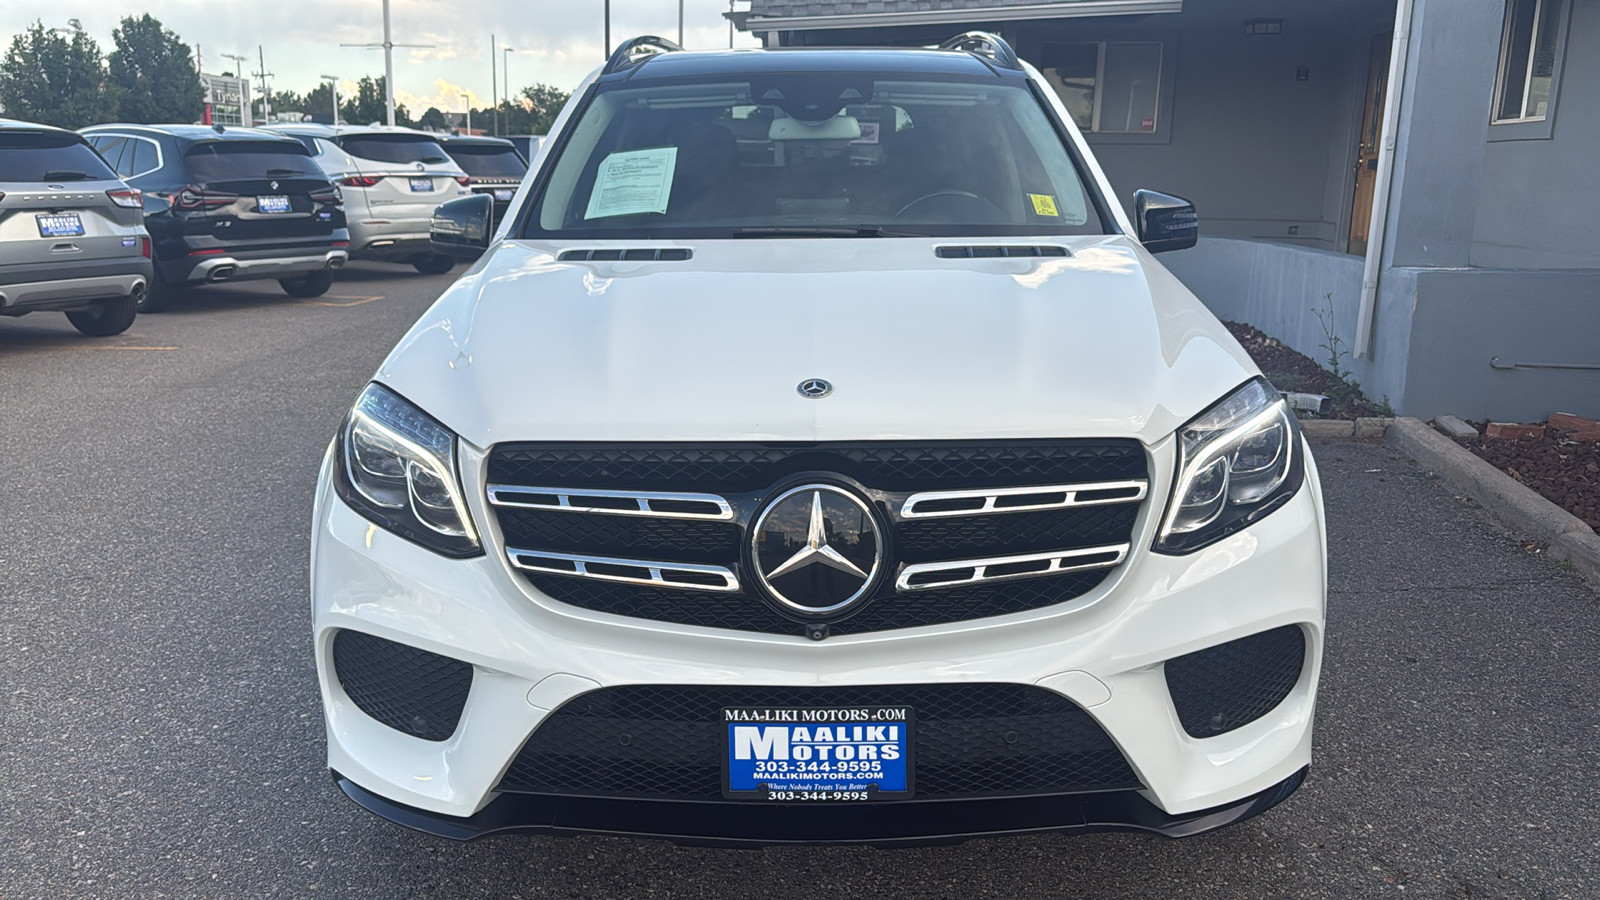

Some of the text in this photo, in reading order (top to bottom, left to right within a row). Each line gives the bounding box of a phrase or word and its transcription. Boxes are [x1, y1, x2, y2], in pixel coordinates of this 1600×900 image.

[755, 761, 881, 772] 303-344-9595
[753, 772, 884, 780] MAALIKIMOTORS.COM
[789, 783, 812, 791] Nobody
[768, 791, 868, 801] 303-344-9595
